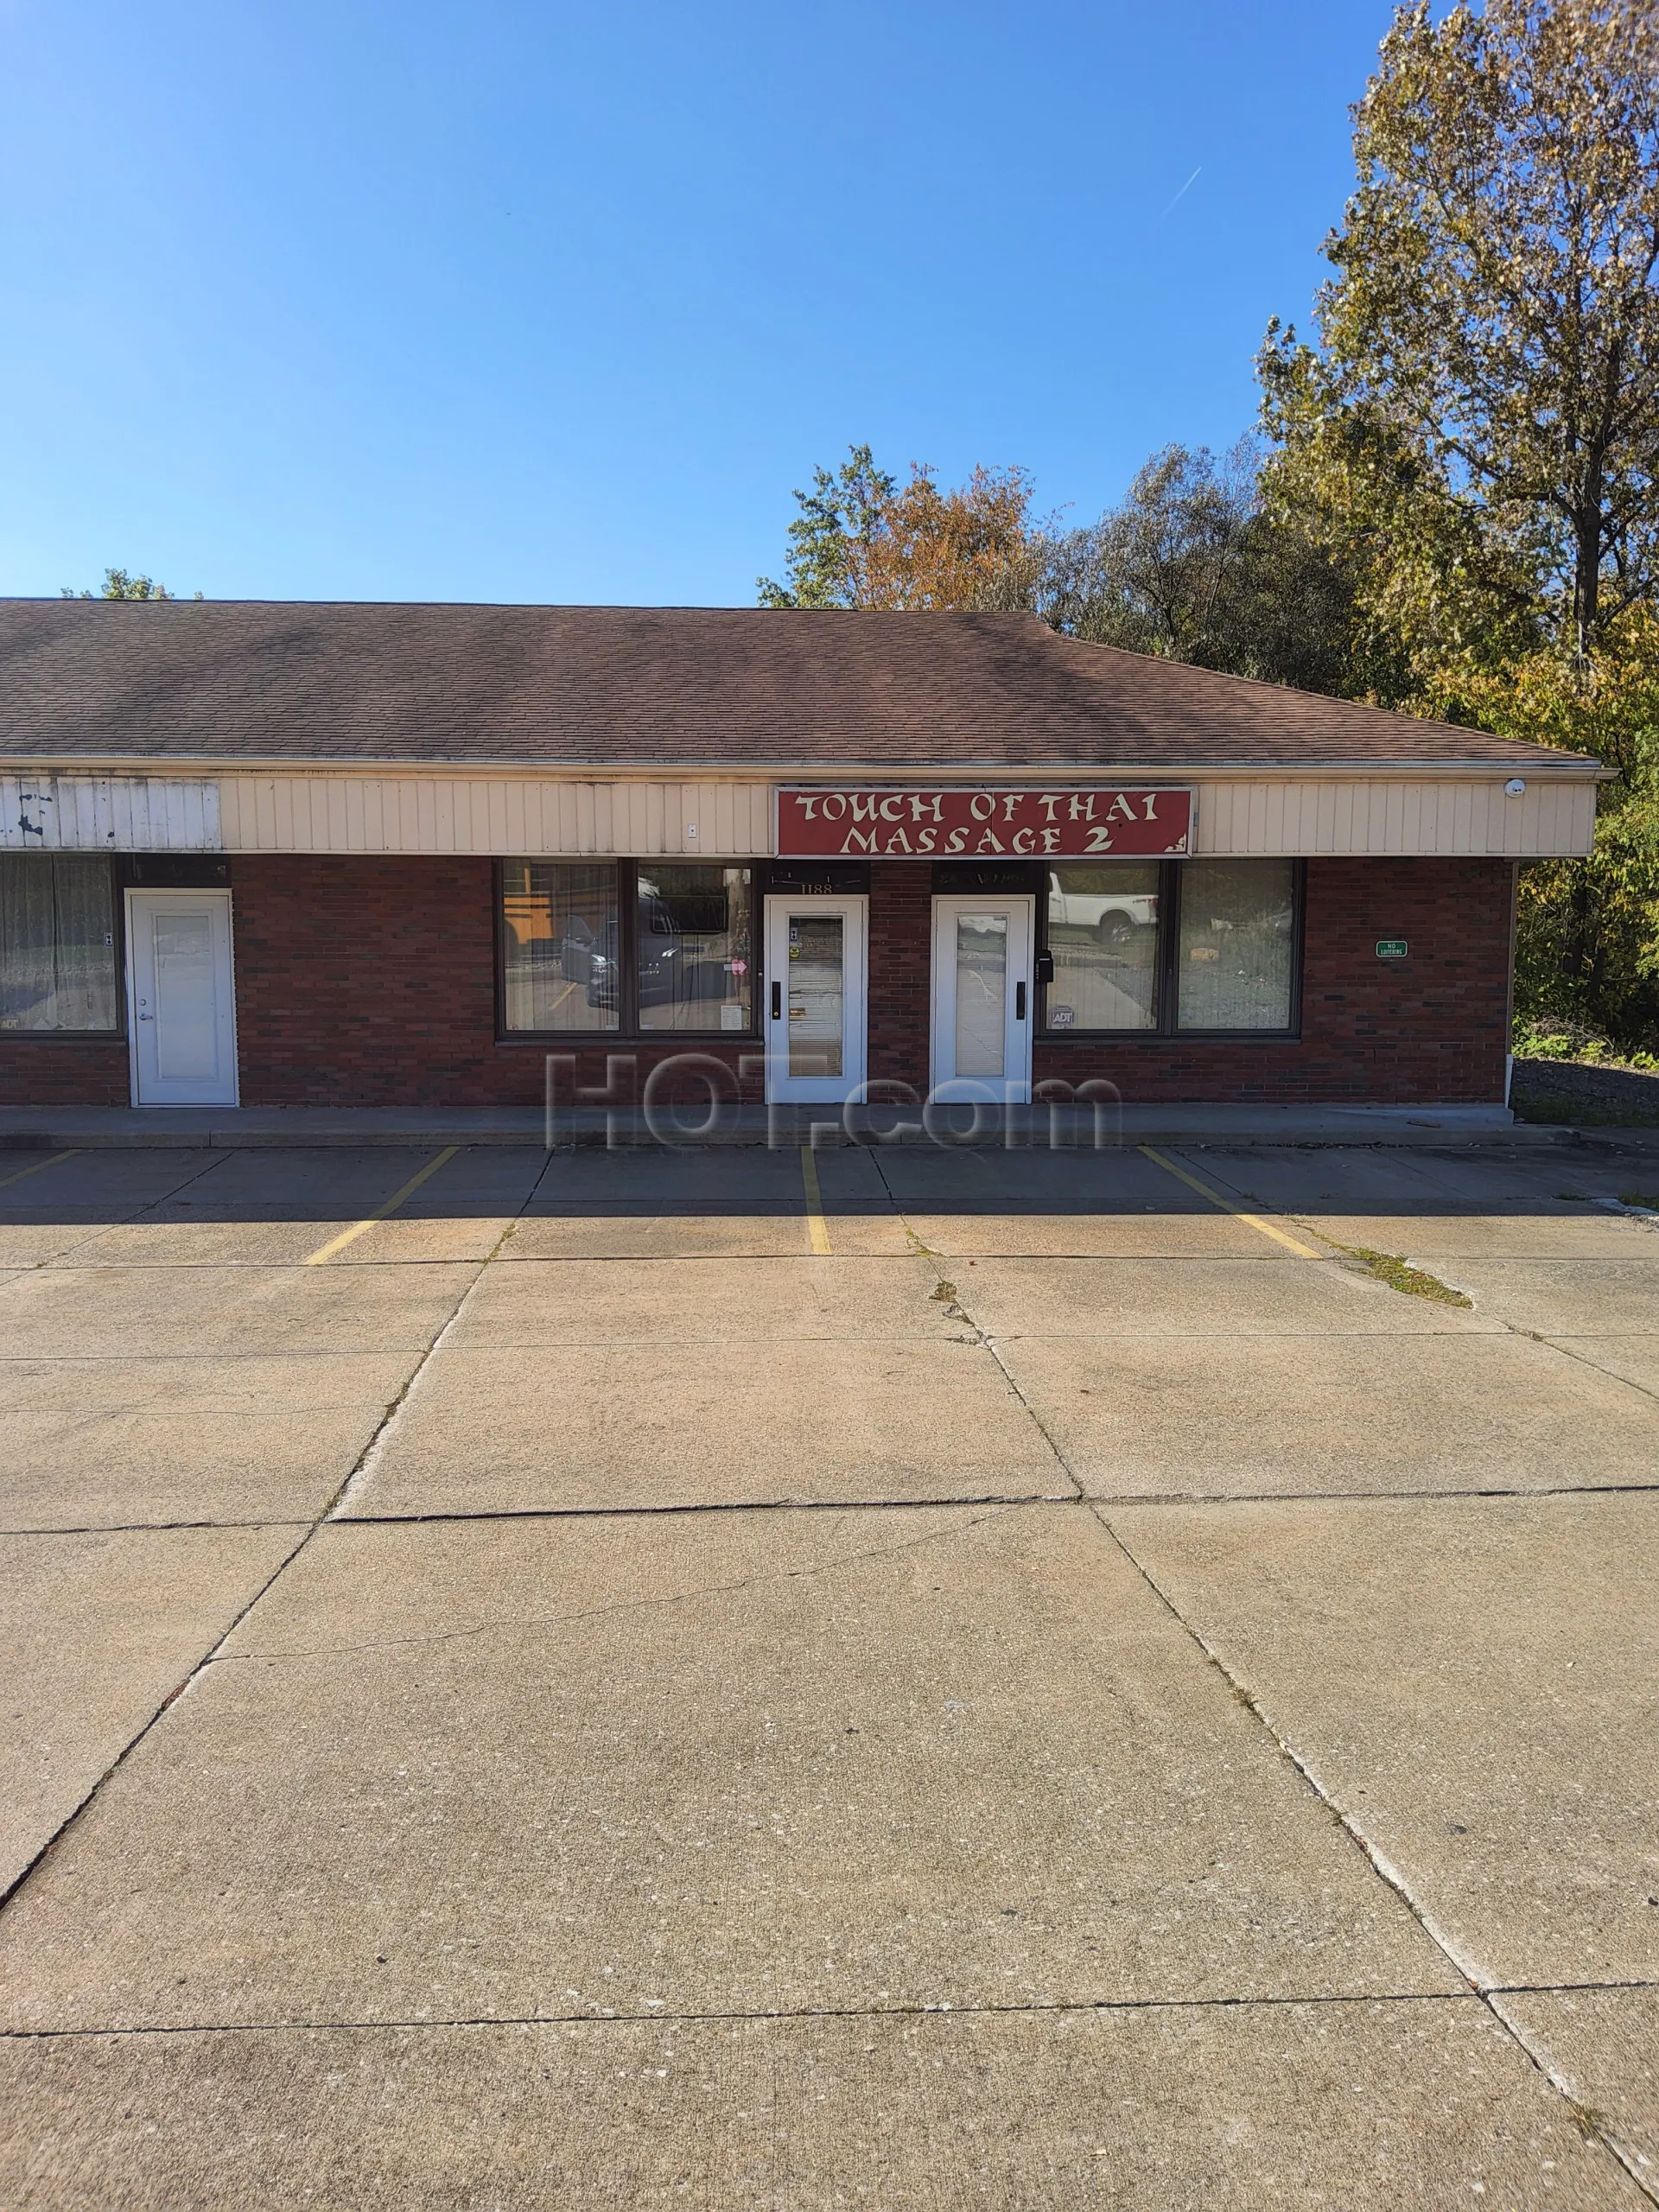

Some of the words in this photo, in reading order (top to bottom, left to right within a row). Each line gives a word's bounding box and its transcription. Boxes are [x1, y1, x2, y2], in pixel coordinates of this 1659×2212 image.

[795, 793, 946, 823] TOUCH
[969, 793, 1025, 823] OF
[1036, 792, 1160, 822] THAI
[838, 826, 1063, 855] MASSAGE
[1082, 826, 1117, 853] 2
[801, 884, 833, 894] 1188
[1053, 1012, 1072, 1022] ADT
